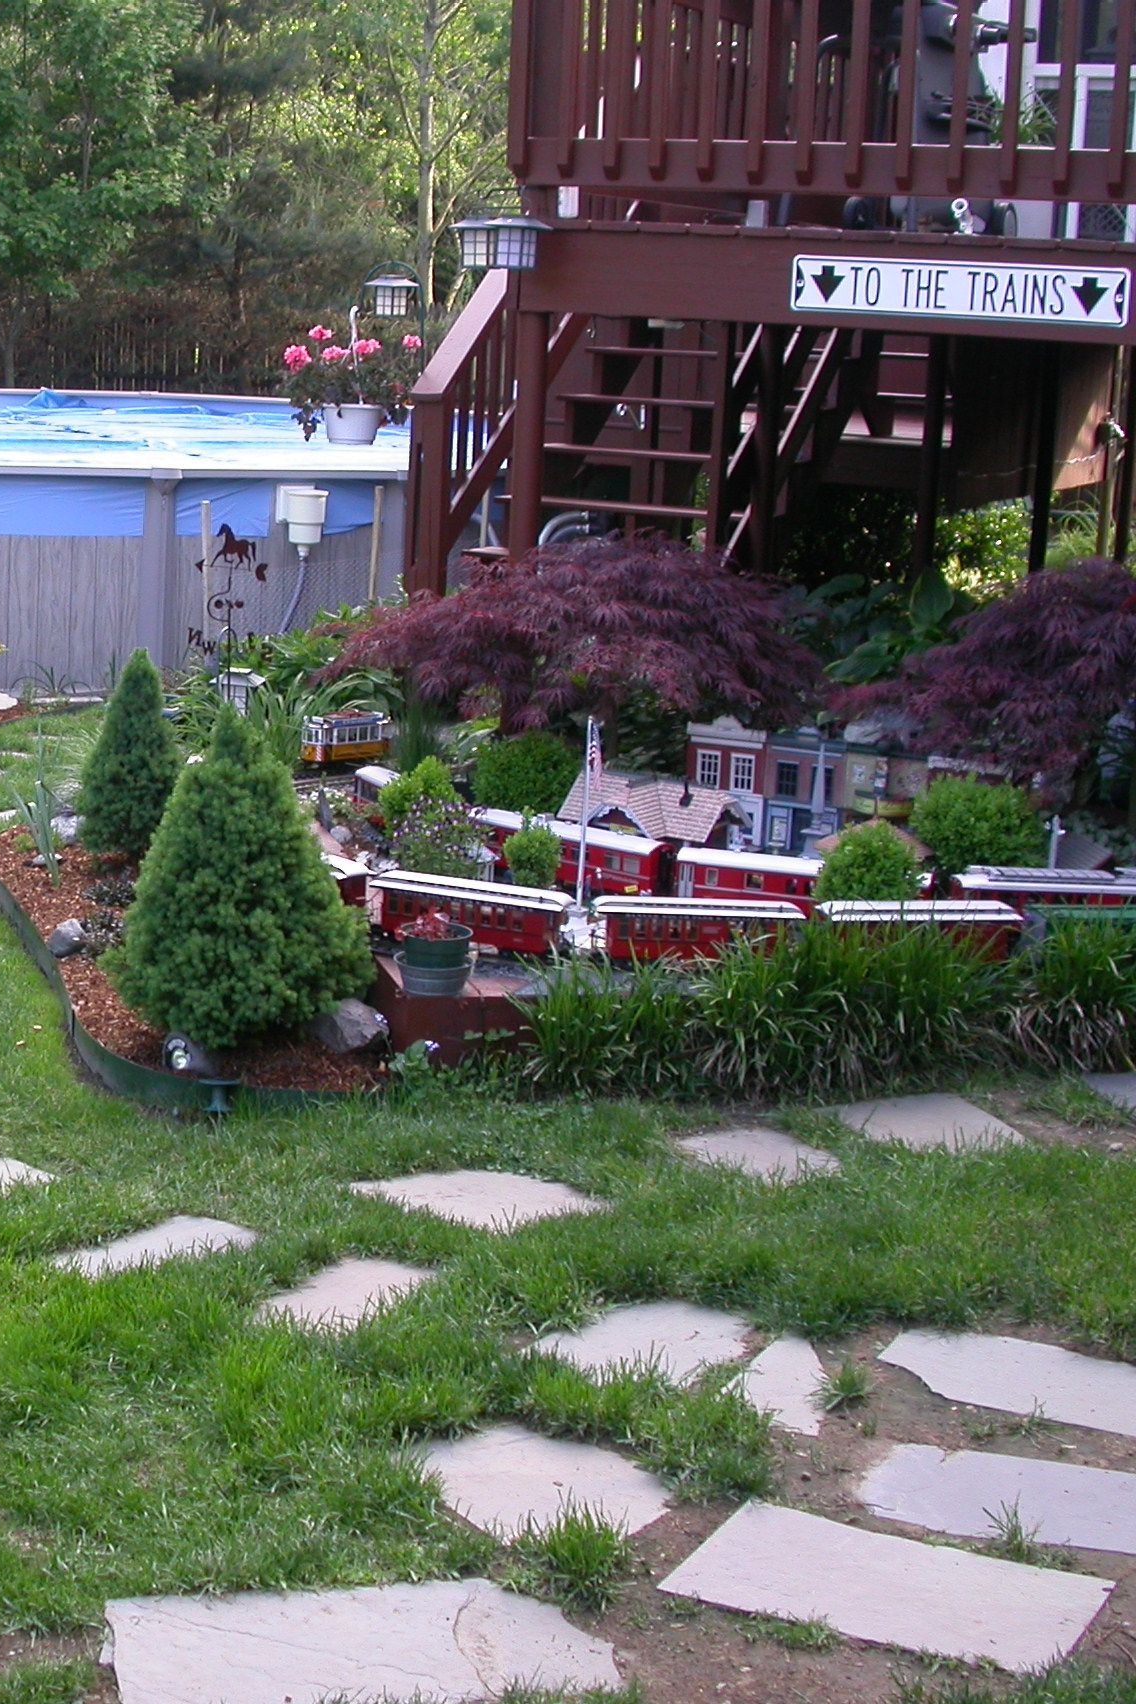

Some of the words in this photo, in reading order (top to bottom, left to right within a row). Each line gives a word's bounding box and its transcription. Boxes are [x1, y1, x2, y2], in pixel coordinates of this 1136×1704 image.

[849, 266, 881, 306] TO
[901, 268, 949, 309] THE
[967, 271, 1067, 315] TRAINS
